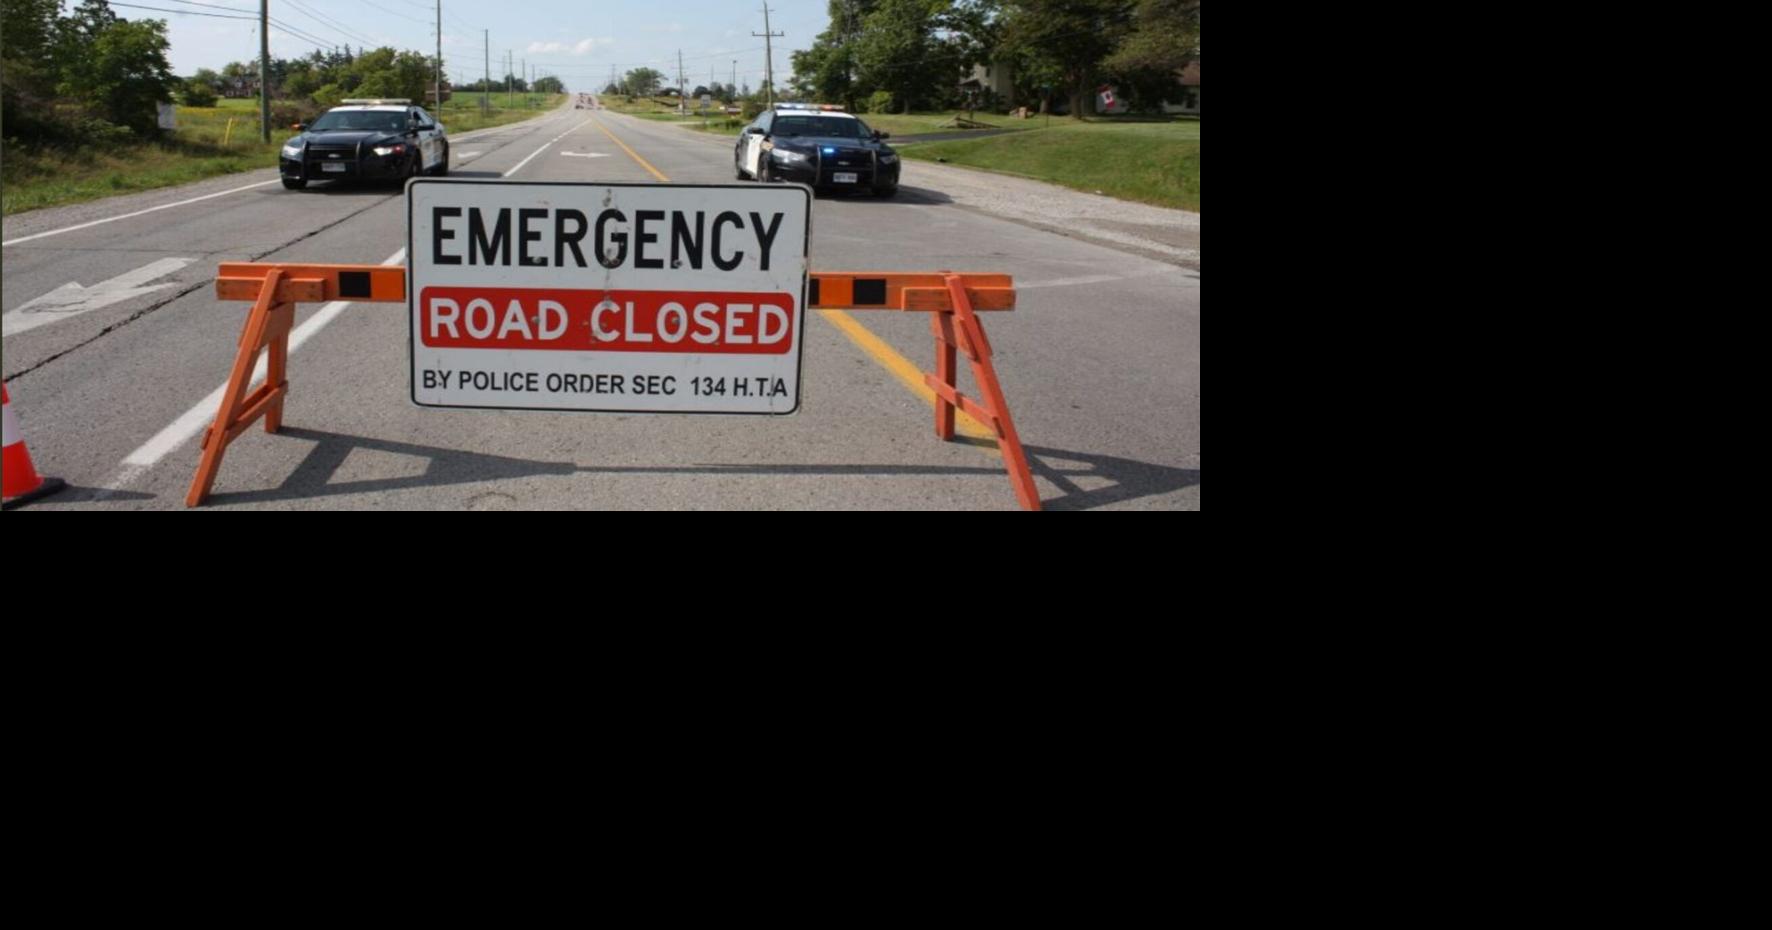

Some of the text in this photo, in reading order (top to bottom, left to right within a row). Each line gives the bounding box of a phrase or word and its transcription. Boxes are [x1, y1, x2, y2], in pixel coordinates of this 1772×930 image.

[432, 206, 785, 271] EMERGENCY
[429, 298, 789, 345] ROAD CLOSED
[423, 369, 452, 389] BY
[459, 371, 539, 392] POLICE
[546, 373, 625, 394] ORDER
[632, 375, 676, 395] SEC
[690, 376, 726, 396] 134
